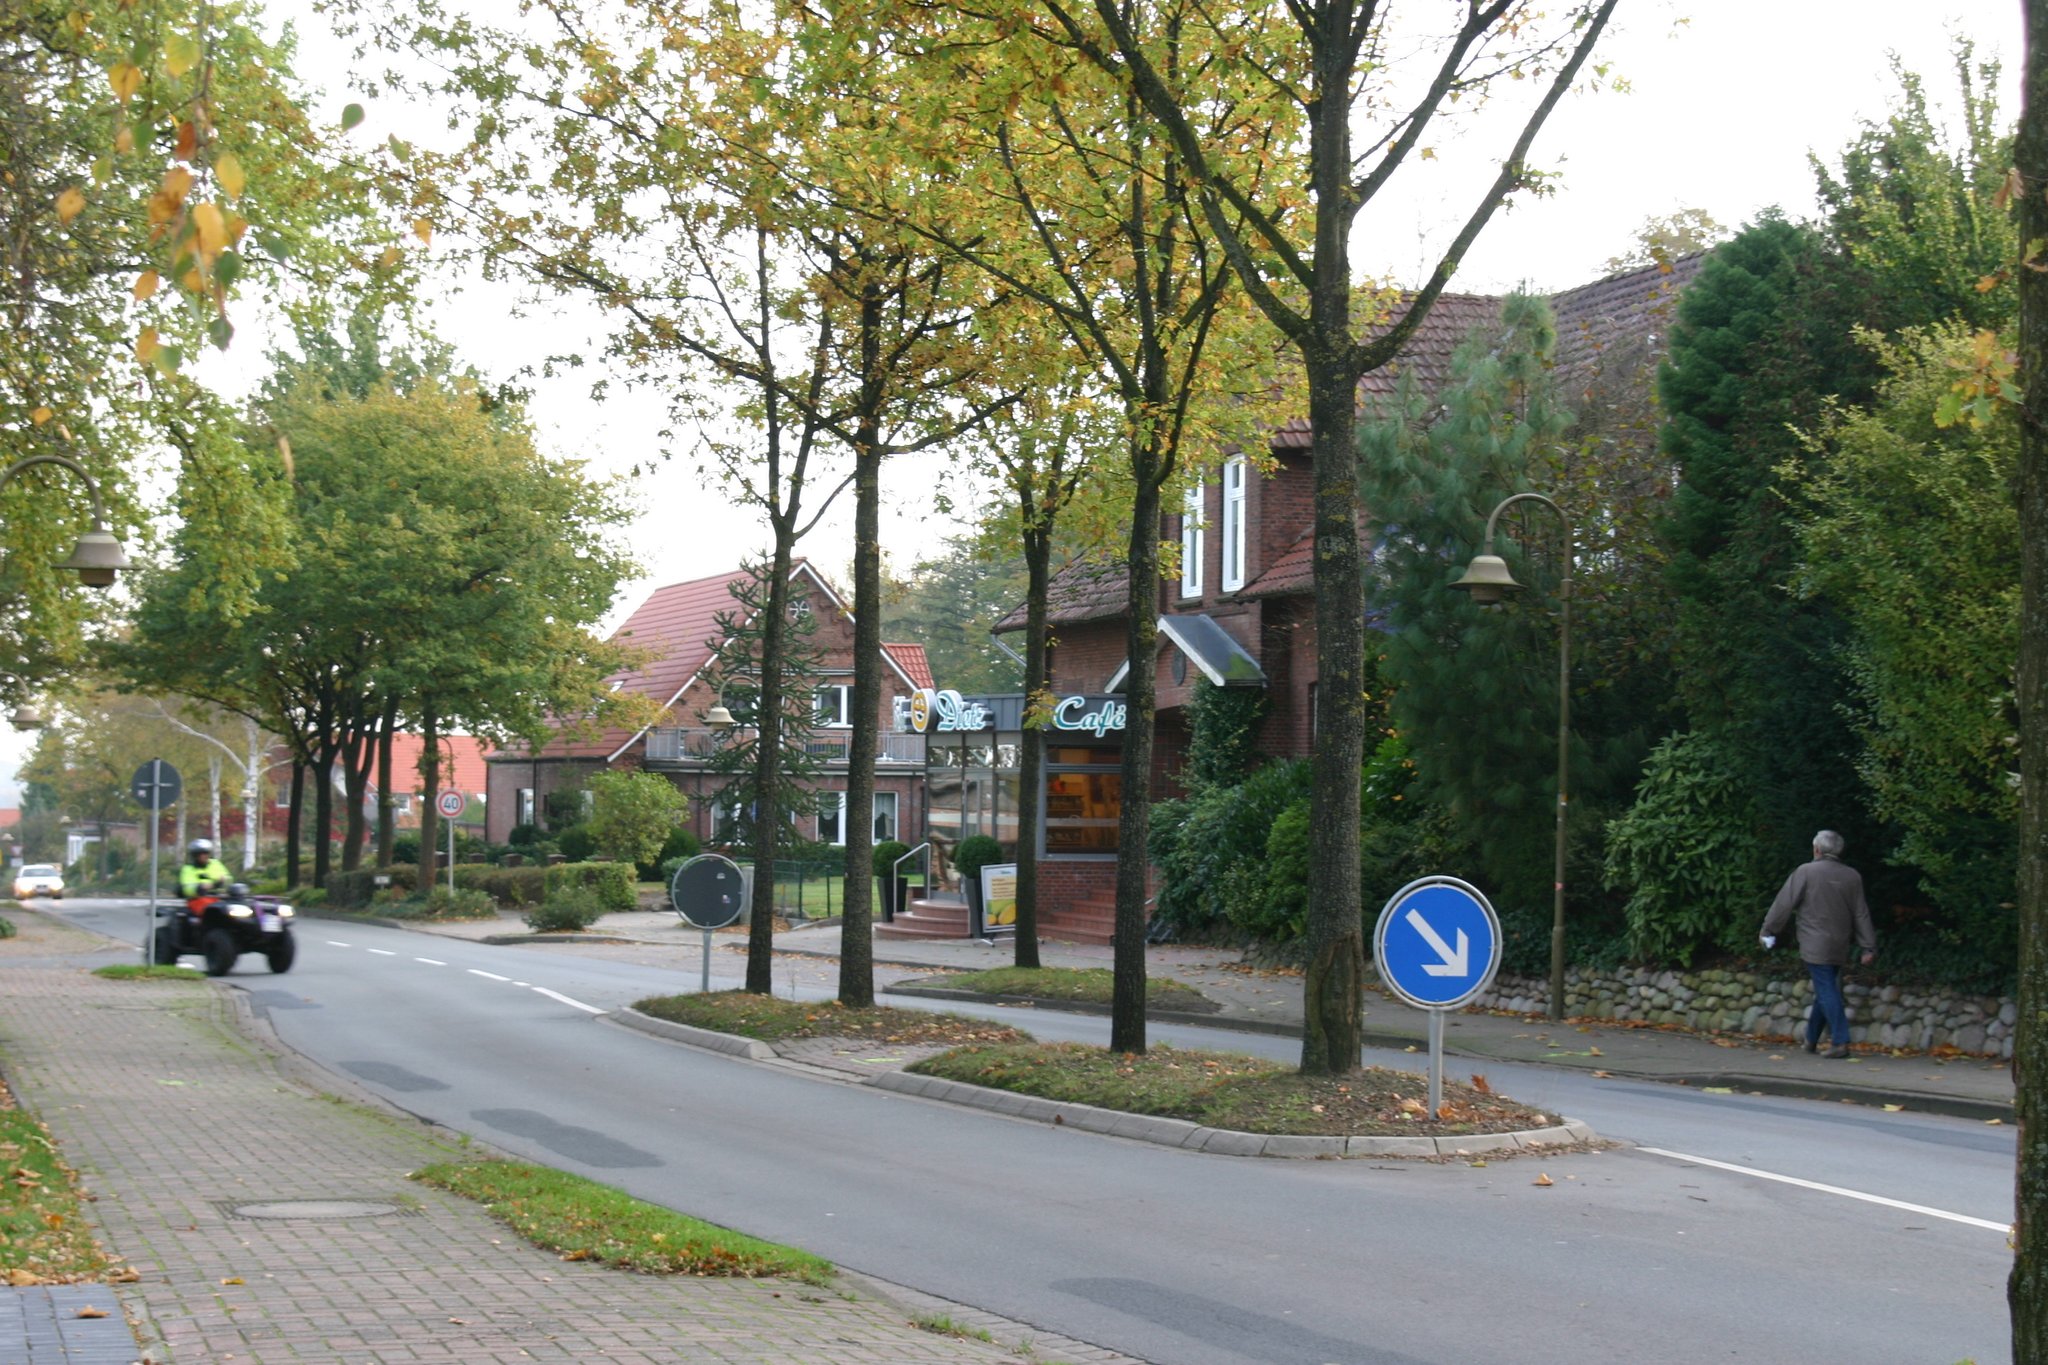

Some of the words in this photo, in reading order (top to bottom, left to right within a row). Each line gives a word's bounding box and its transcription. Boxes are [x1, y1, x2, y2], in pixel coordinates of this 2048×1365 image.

[936, 690, 987, 731] Dietz
[1053, 696, 1127, 738] Café
[443, 797, 459, 810] 40
